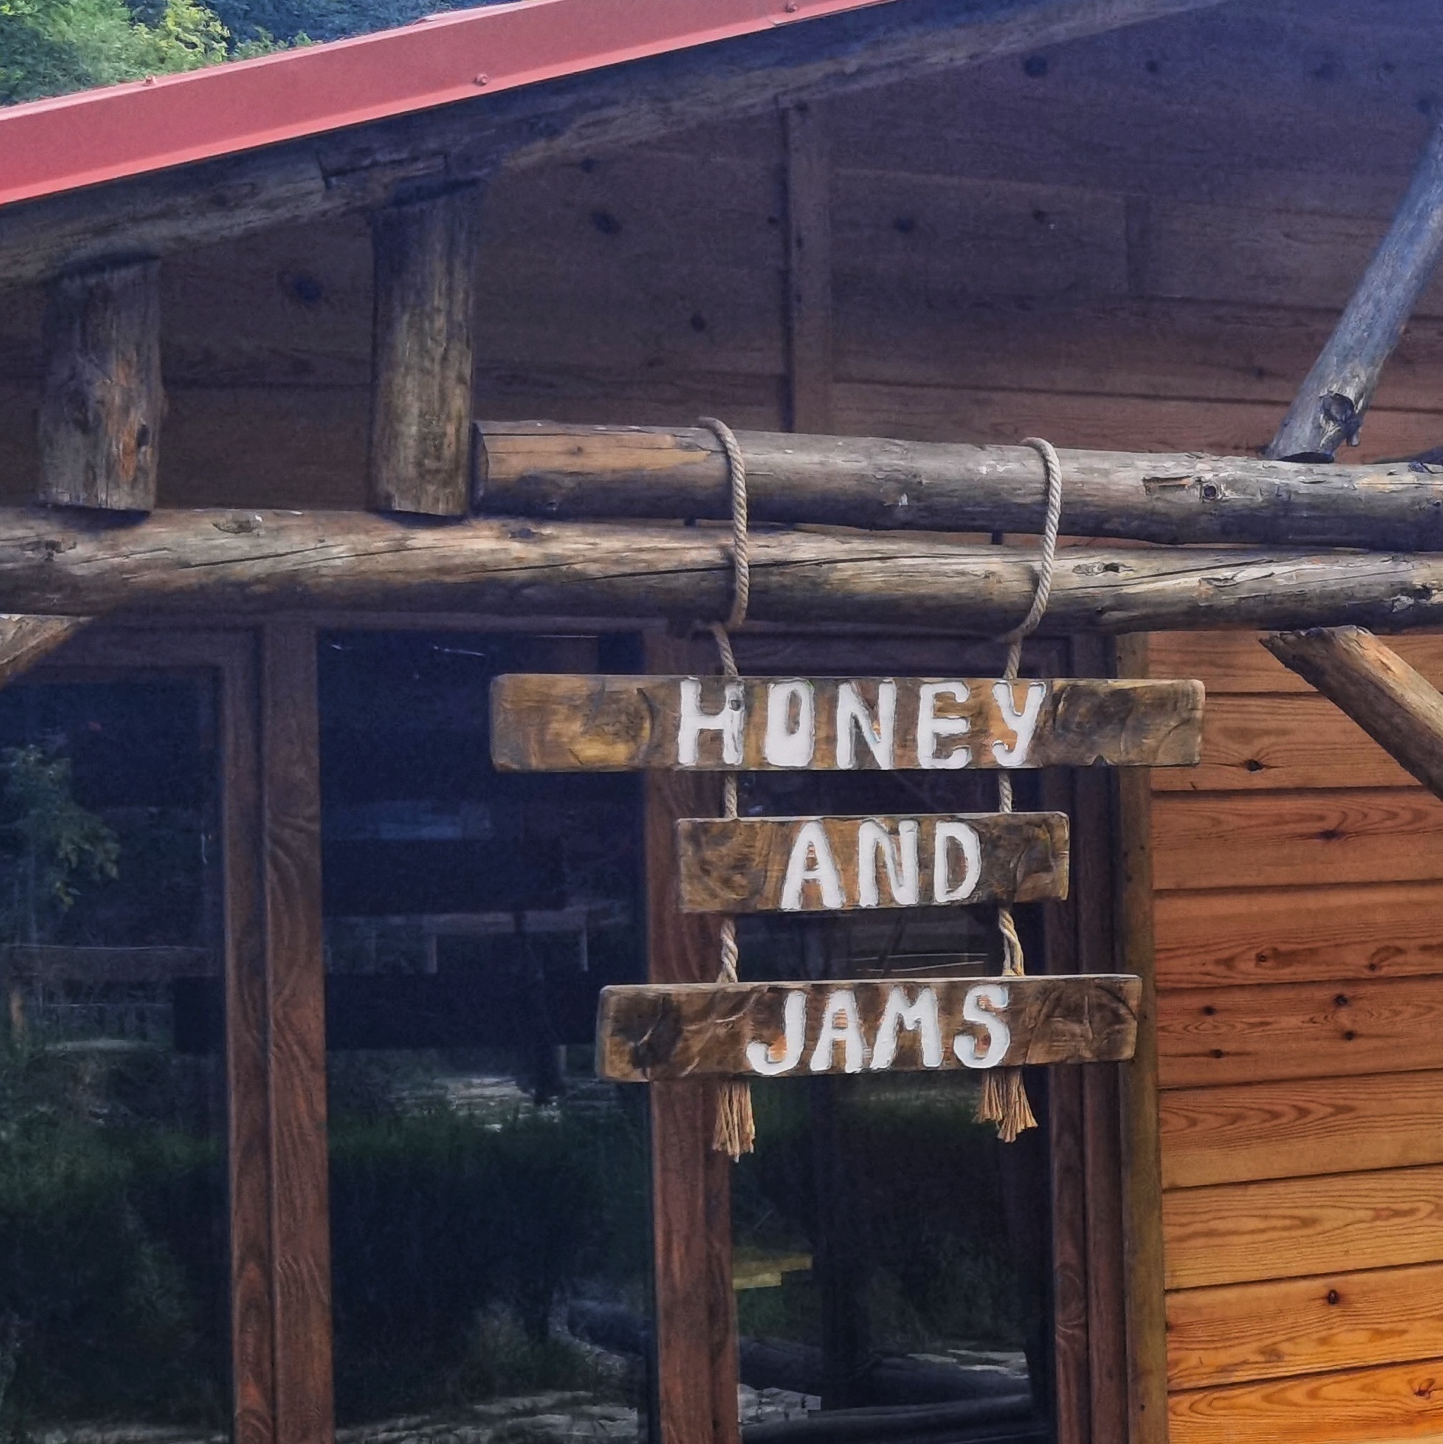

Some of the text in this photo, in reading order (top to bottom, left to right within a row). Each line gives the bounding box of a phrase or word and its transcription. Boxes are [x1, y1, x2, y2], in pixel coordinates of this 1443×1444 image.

[678, 676, 1048, 769] HONEY
[780, 820, 982, 910] AND
[745, 985, 1010, 1076] JAMS
